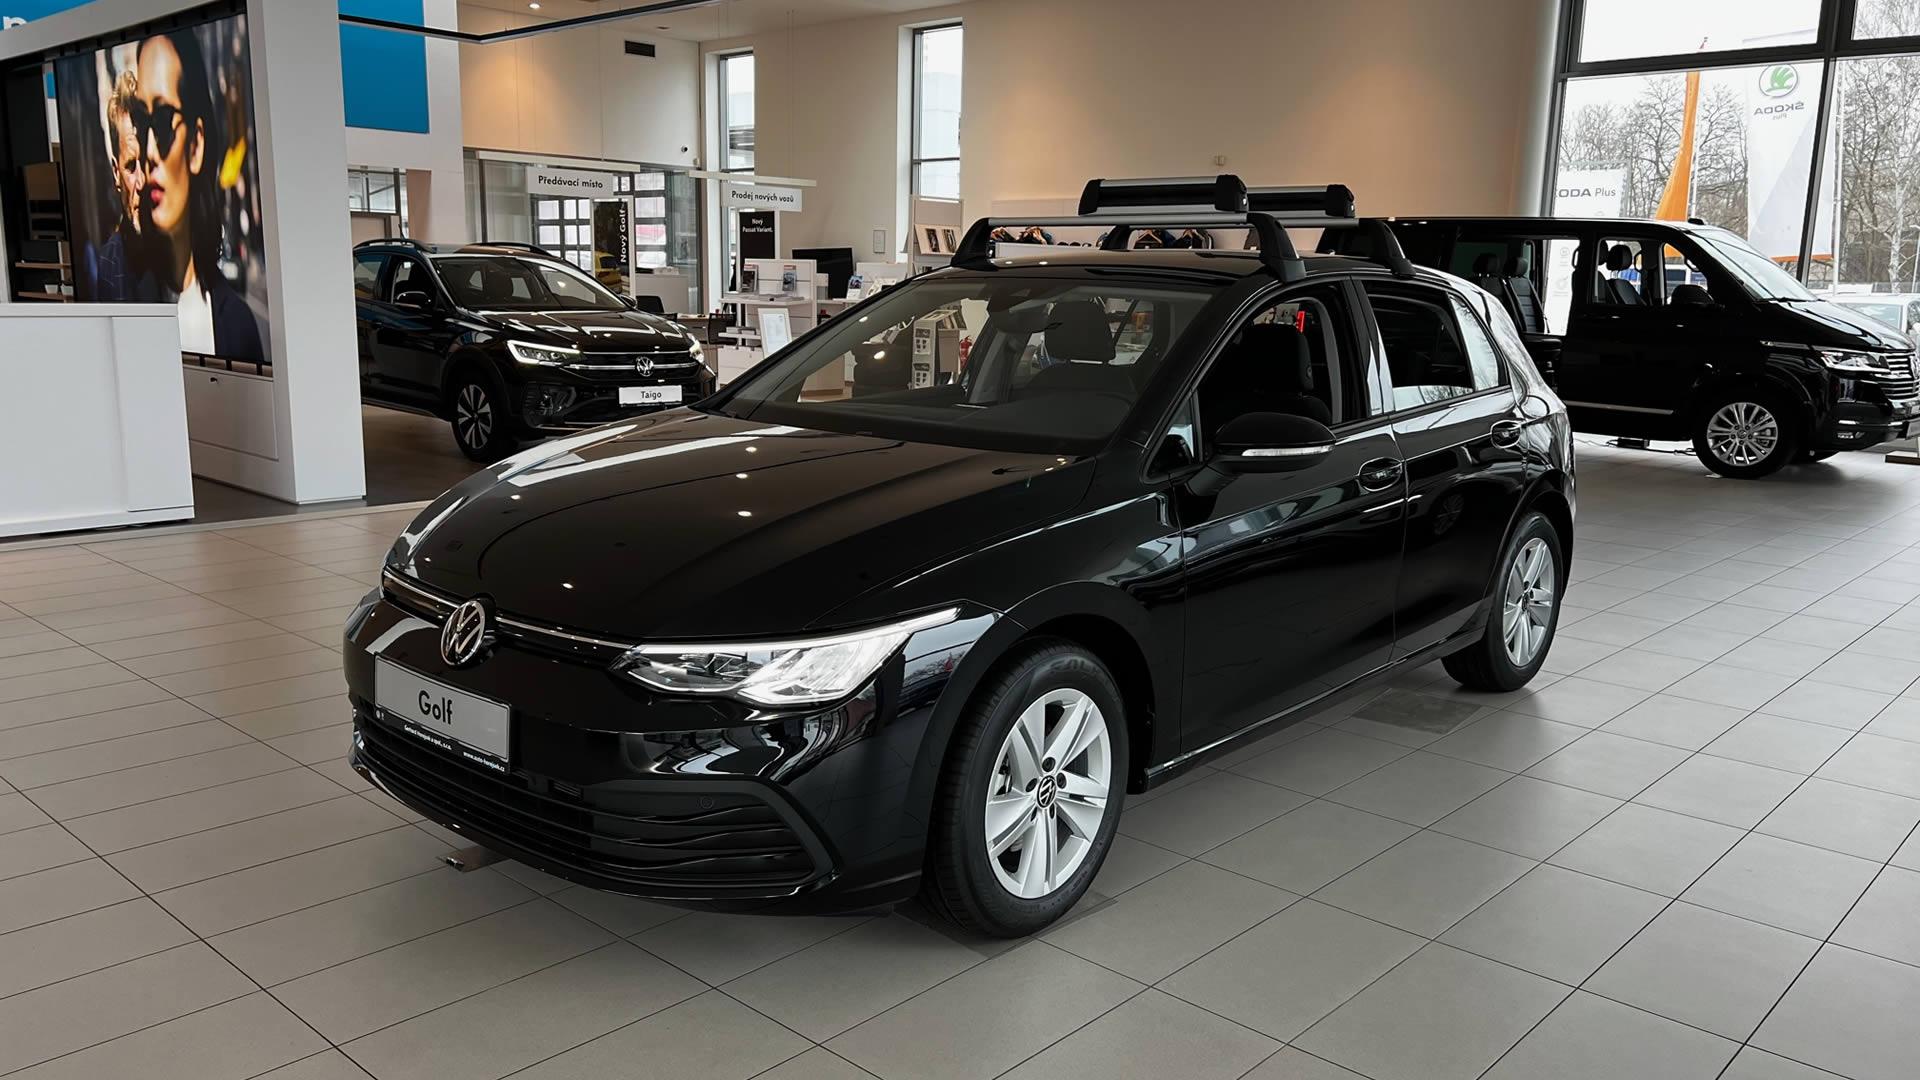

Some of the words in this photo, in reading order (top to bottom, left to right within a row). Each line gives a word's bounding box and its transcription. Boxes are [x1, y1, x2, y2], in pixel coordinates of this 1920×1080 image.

[538, 175, 580, 187] Předávací
[731, 190, 754, 201] Prodej
[755, 193, 778, 202] nových
[1555, 188, 1591, 198] ODA
[1595, 187, 1616, 197] Plus
[619, 234, 627, 263] Nový
[641, 390, 662, 400] Taigo
[418, 689, 453, 725] Golf
